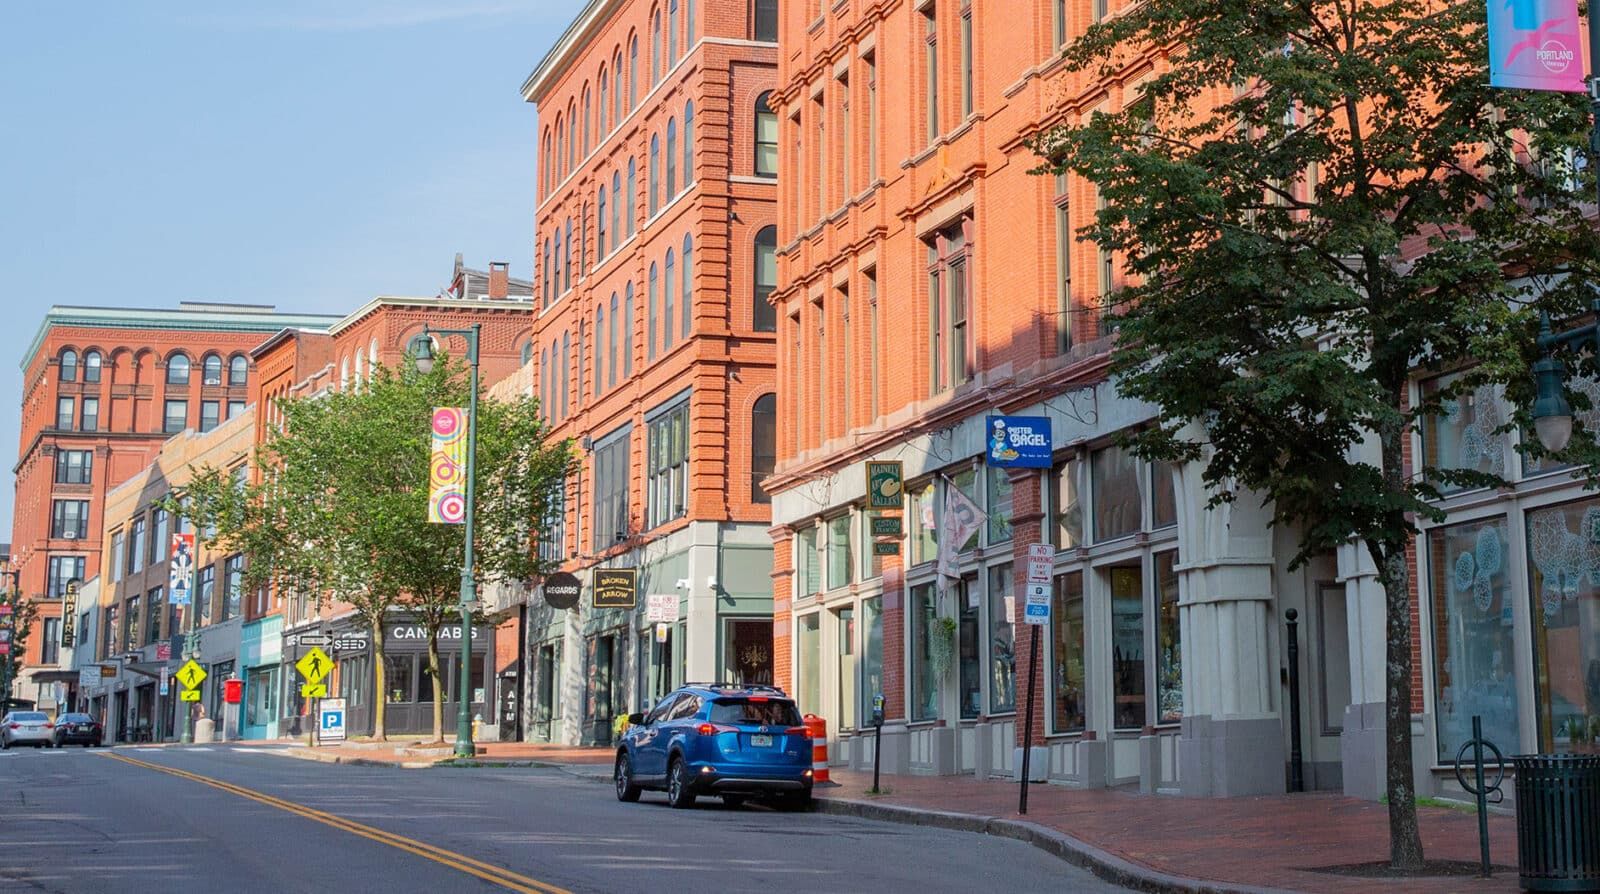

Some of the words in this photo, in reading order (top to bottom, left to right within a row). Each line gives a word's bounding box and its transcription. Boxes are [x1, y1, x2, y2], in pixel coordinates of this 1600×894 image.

[1536, 50, 1573, 60] PORTLAND
[1010, 434, 1046, 447] BAGEL
[872, 493, 900, 505] GALLERY
[1037, 547, 1047, 555] NO
[1030, 556, 1053, 564] PARKING
[601, 577, 629, 585] BROKEN
[546, 586, 578, 594] REGARDS
[601, 591, 628, 599] ARROW
[64, 583, 77, 644] EMPIRE
[393, 627, 478, 639] CANABS
[334, 639, 366, 649] SEED
[506, 690, 515, 720] ATM
[327, 715, 337, 727] P
